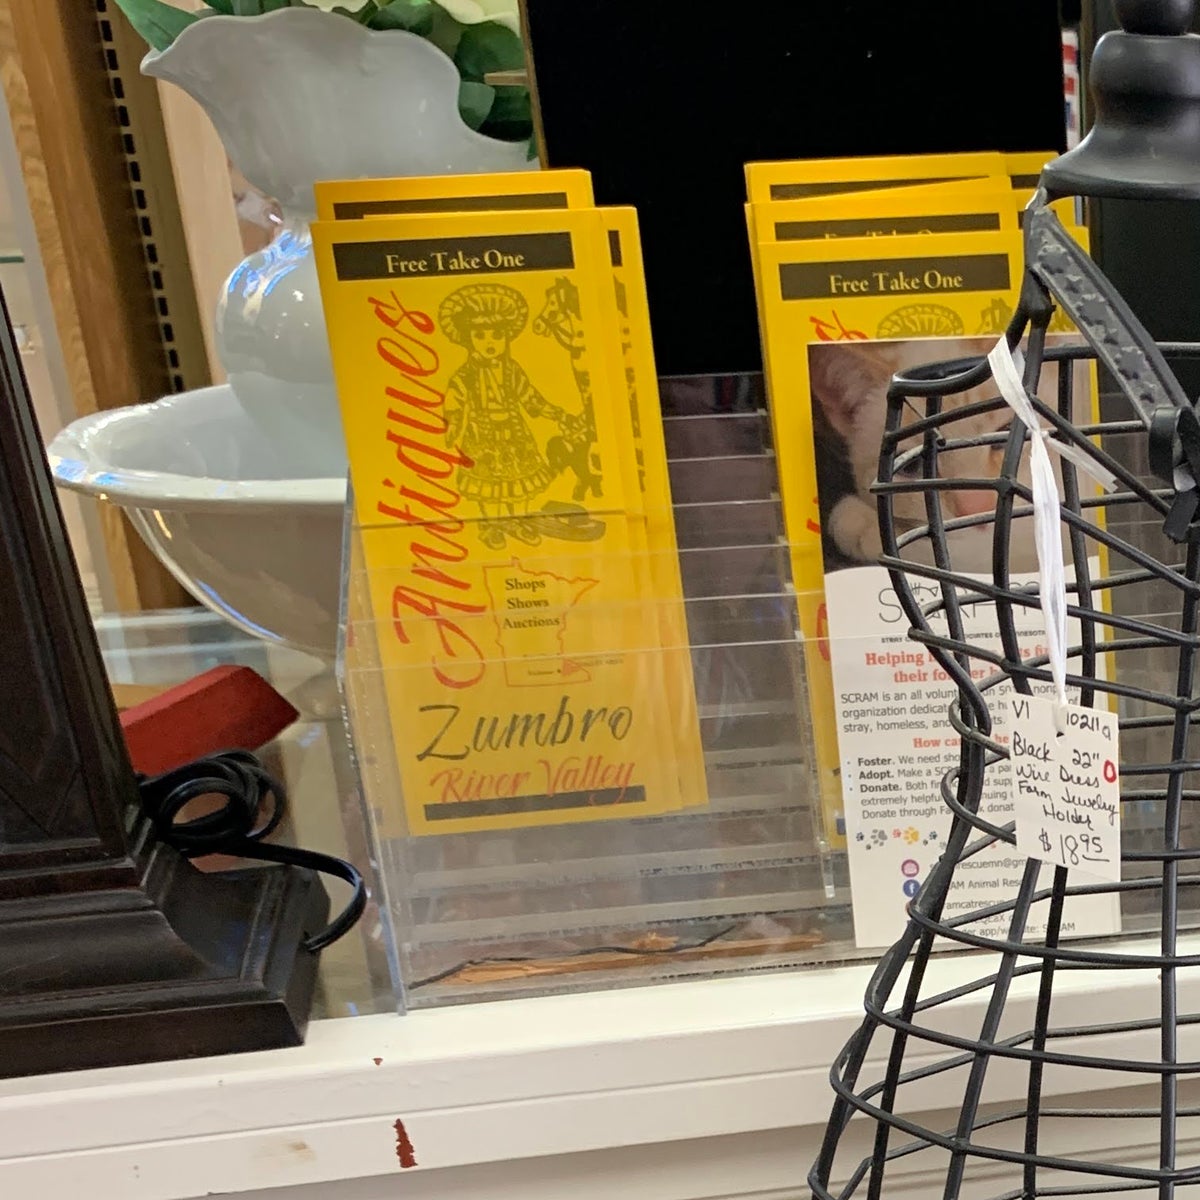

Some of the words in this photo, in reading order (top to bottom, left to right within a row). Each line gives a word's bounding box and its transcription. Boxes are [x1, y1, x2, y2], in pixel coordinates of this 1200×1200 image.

[386, 253, 427, 274] Free
[431, 249, 480, 271] Take
[484, 249, 525, 269] One
[829, 274, 869, 295] Free
[873, 271, 921, 292] Take
[924, 269, 963, 289] One
[368, 290, 487, 690] Antiques
[505, 578, 547, 594] Shops
[506, 597, 549, 611] Shows
[502, 615, 561, 632] Auctions
[865, 651, 924, 668] Helping
[894, 669, 929, 684] their
[840, 691, 878, 704] SCRAM
[882, 691, 891, 702] is
[894, 692, 907, 701] an
[910, 690, 922, 700] all
[842, 705, 907, 720] organization
[417, 695, 633, 762] Zumbro
[843, 722, 873, 734] stray,
[877, 720, 929, 731] homeless,
[913, 737, 941, 749] How
[1013, 731, 1055, 762] Black
[857, 756, 895, 768] Foster.
[898, 755, 915, 765] We
[917, 754, 941, 764] need
[429, 768, 532, 804] River
[537, 755, 636, 806] Valley
[859, 769, 895, 781] Adopt.
[897, 768, 923, 779] Make
[1016, 763, 1051, 782] Wire
[1060, 765, 1100, 788] Dress
[860, 782, 903, 793] Donate.
[905, 781, 928, 791] Both
[860, 795, 908, 807] extremely
[1061, 787, 1119, 826] Jewelry
[862, 809, 897, 820] Donate
[899, 806, 937, 818] through
[1043, 804, 1094, 832] Holder
[967, 877, 1000, 889] Animal
